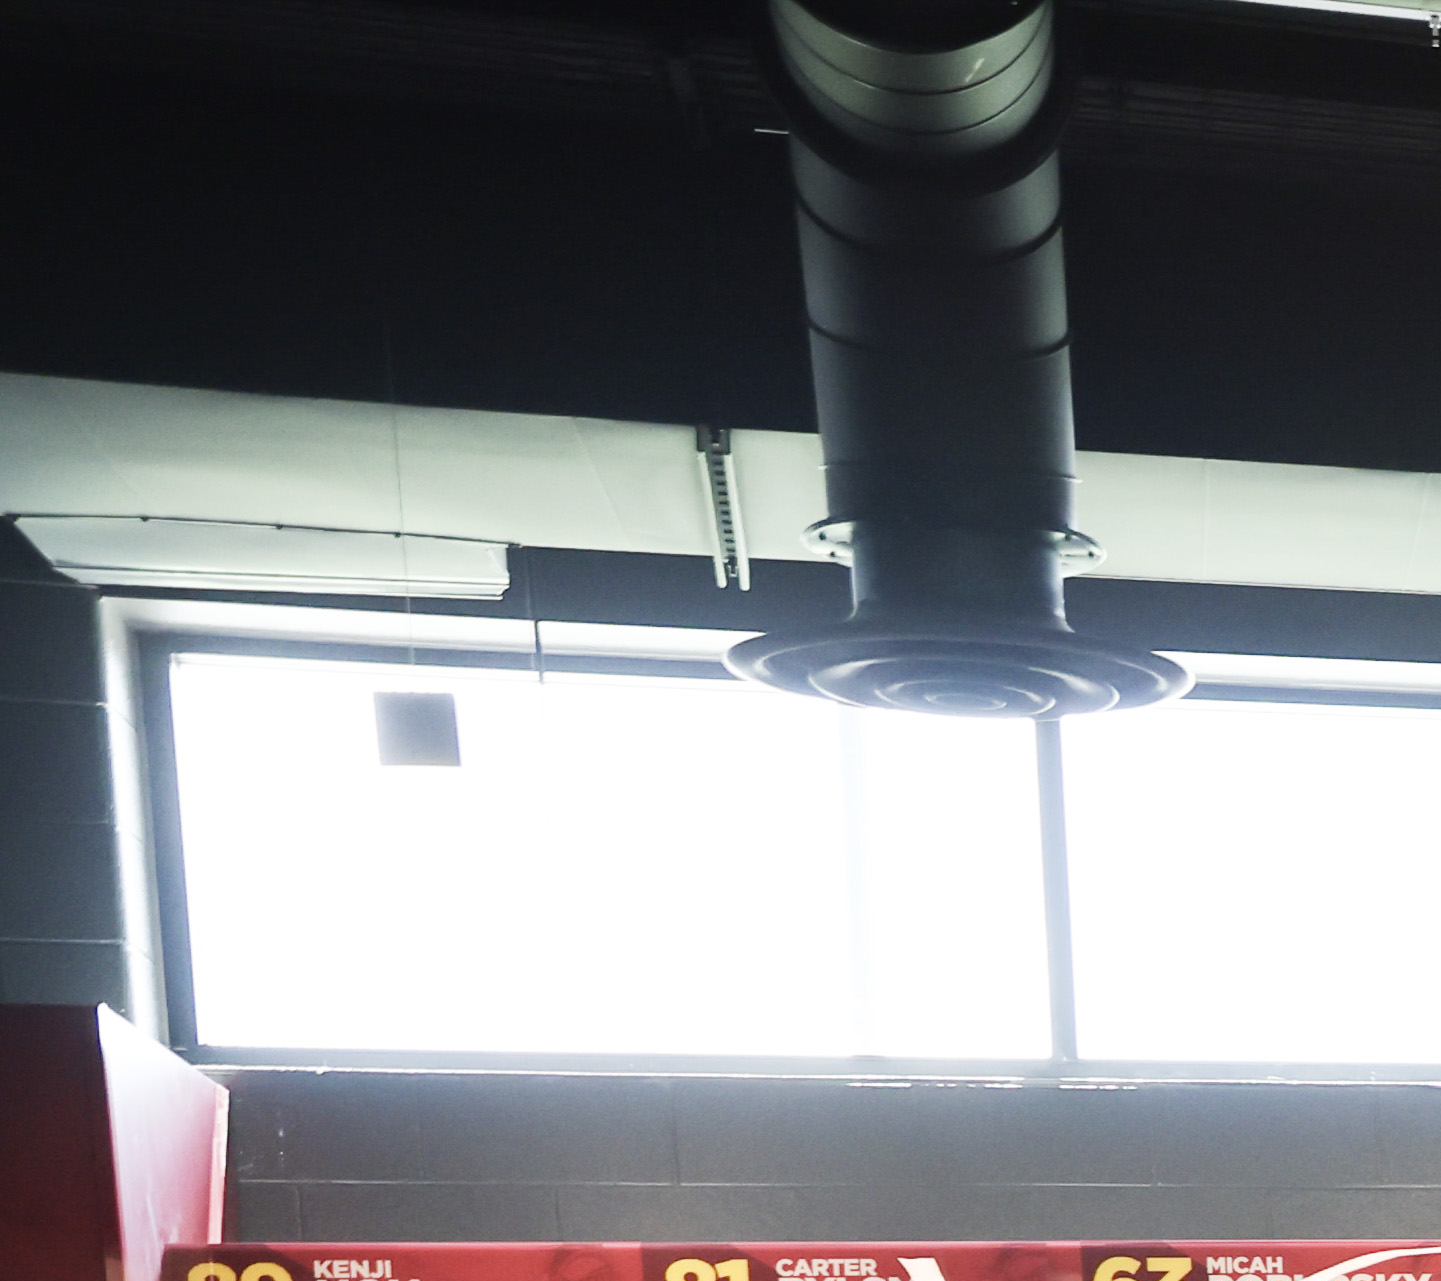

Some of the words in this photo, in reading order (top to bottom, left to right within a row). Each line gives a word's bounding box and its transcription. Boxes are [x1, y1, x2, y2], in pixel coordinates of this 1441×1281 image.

[313, 1259, 392, 1278] KENJI
[776, 1258, 877, 1276] CARTER
[1206, 1256, 1284, 1274] MICAH
